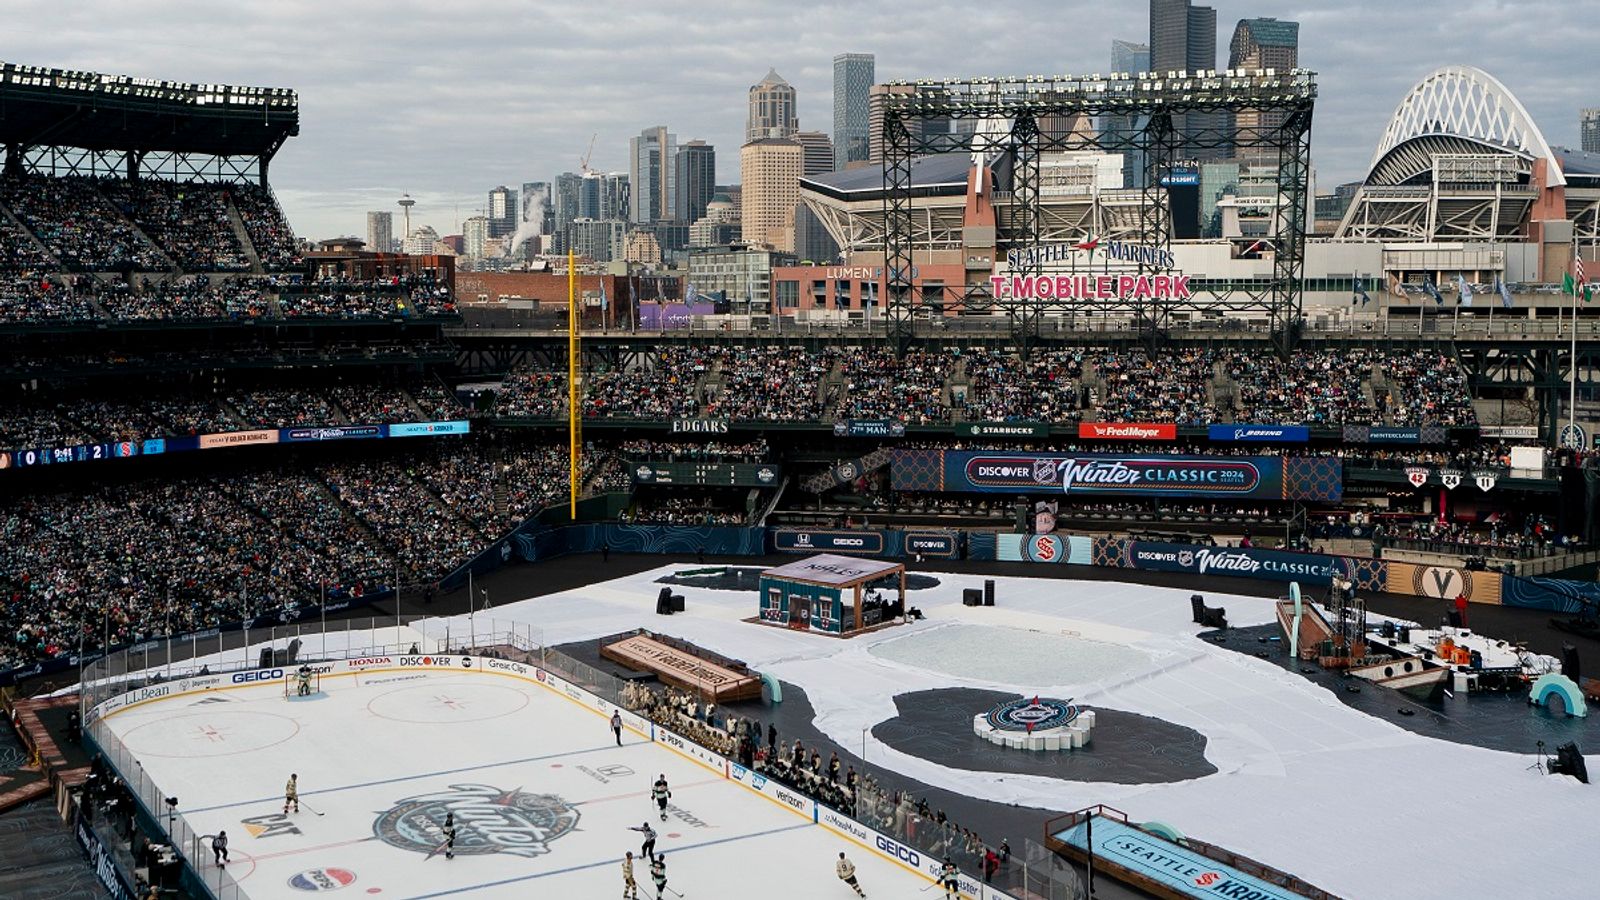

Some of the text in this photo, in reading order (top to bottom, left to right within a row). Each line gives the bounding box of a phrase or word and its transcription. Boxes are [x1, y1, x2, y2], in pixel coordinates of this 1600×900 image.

[1007, 239, 1175, 269] SEATTLE MARINERS
[826, 267, 873, 279] LUMEN
[990, 275, 1192, 299] T-MOBILE PARK
[673, 421, 728, 433] EDGARS
[866, 426, 887, 434] MAN
[1246, 429, 1283, 437] BOEING
[26, 452, 35, 465] 0
[93, 445, 102, 459] 2
[978, 466, 1030, 477] DISCOVER
[1057, 458, 1142, 496] Winter
[1145, 469, 1218, 483] CLASSIC
[1220, 470, 1245, 478] 2024
[1411, 473, 1424, 483] 42
[1445, 476, 1457, 485] 24
[1481, 478, 1490, 487] 11
[833, 538, 864, 546] GEICO
[1138, 551, 1177, 562] DISCOVER
[1195, 549, 1262, 574] Winter
[1263, 560, 1319, 576] CLASSIC
[348, 656, 392, 667] HONDA
[400, 656, 451, 667] DISCOVER
[488, 659, 527, 674] Great Clips
[232, 669, 284, 684] GEICO
[125, 685, 170, 705] L.L.Bean
[667, 734, 684, 749] PEPSI
[776, 789, 804, 810] verizon
[240, 813, 302, 839] CAT
[830, 815, 867, 840] MassMutual
[876, 835, 920, 868] GEICO
[1120, 841, 1196, 877] SEATTLE
